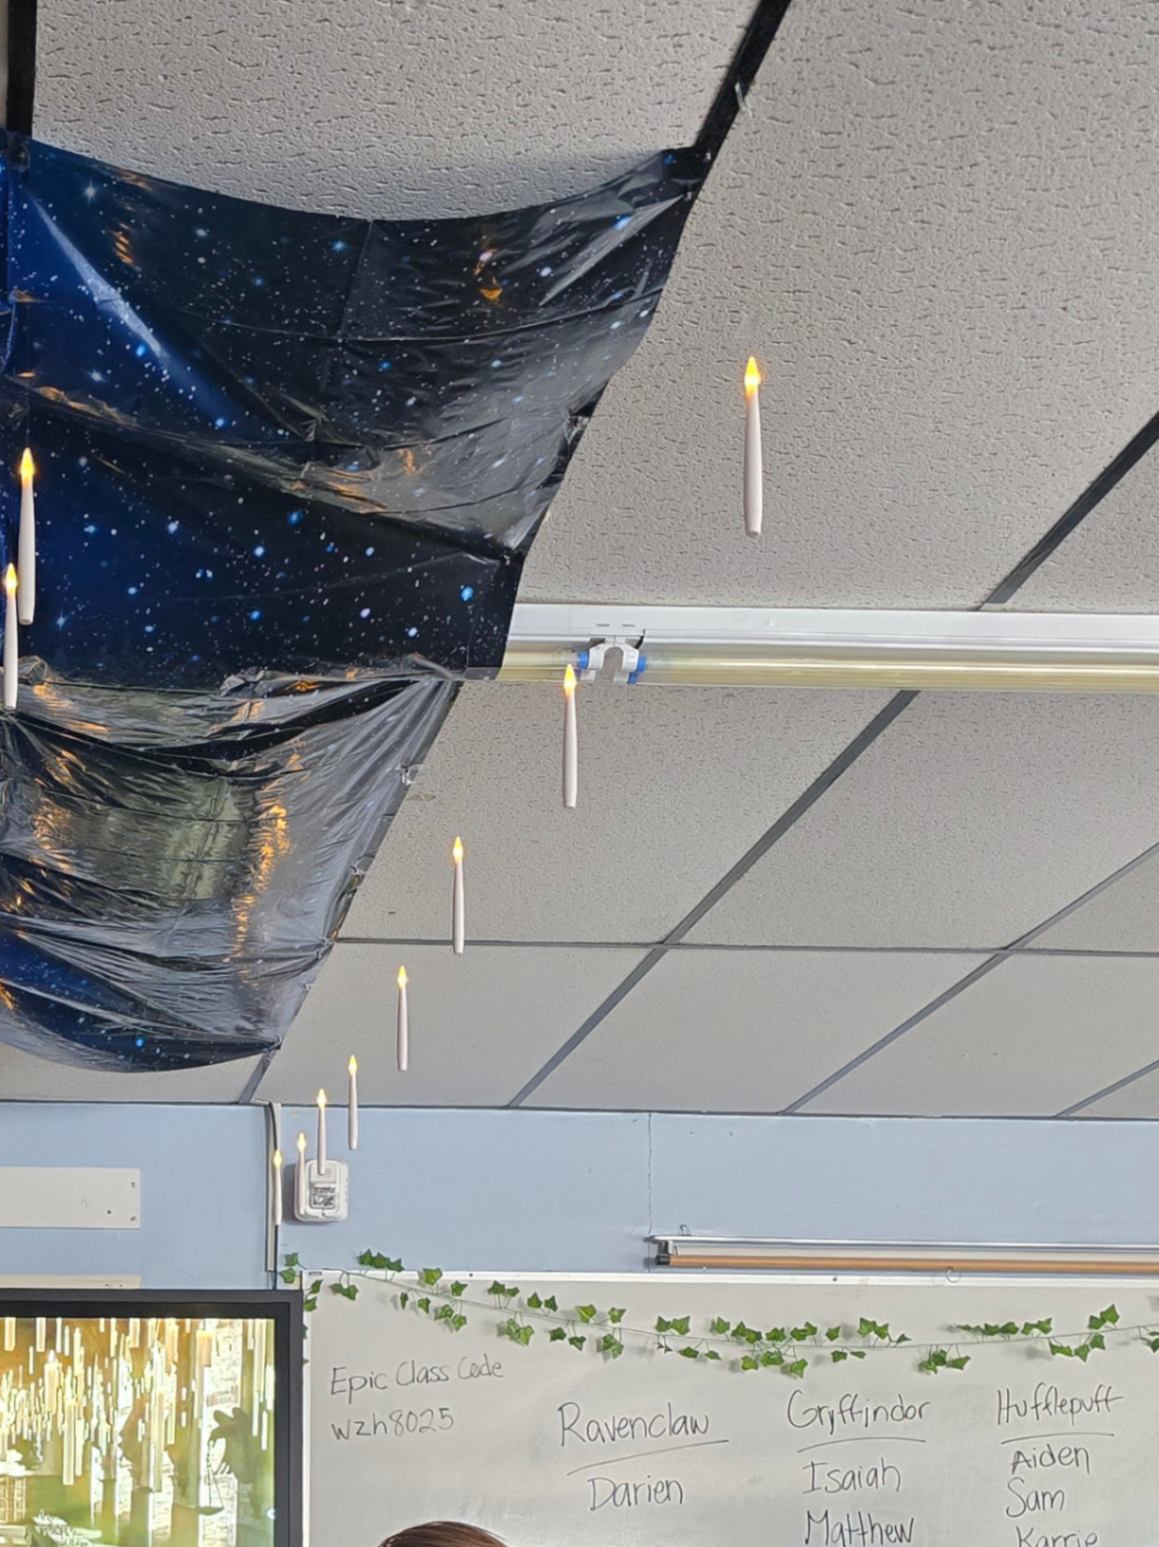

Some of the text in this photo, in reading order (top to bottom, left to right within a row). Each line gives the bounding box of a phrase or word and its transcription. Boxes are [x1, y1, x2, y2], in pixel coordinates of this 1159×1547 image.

[330, 1353, 505, 1404] Epic Class Code
[557, 1401, 709, 1447] Ravenclaw
[787, 1389, 931, 1436] Gryffindor
[996, 1381, 1124, 1426] Hufflepuff
[801, 1456, 901, 1494] Isaiah
[1009, 1443, 1090, 1475] Aiden
[587, 1474, 683, 1511] Darien
[1005, 1476, 1065, 1518] Sam
